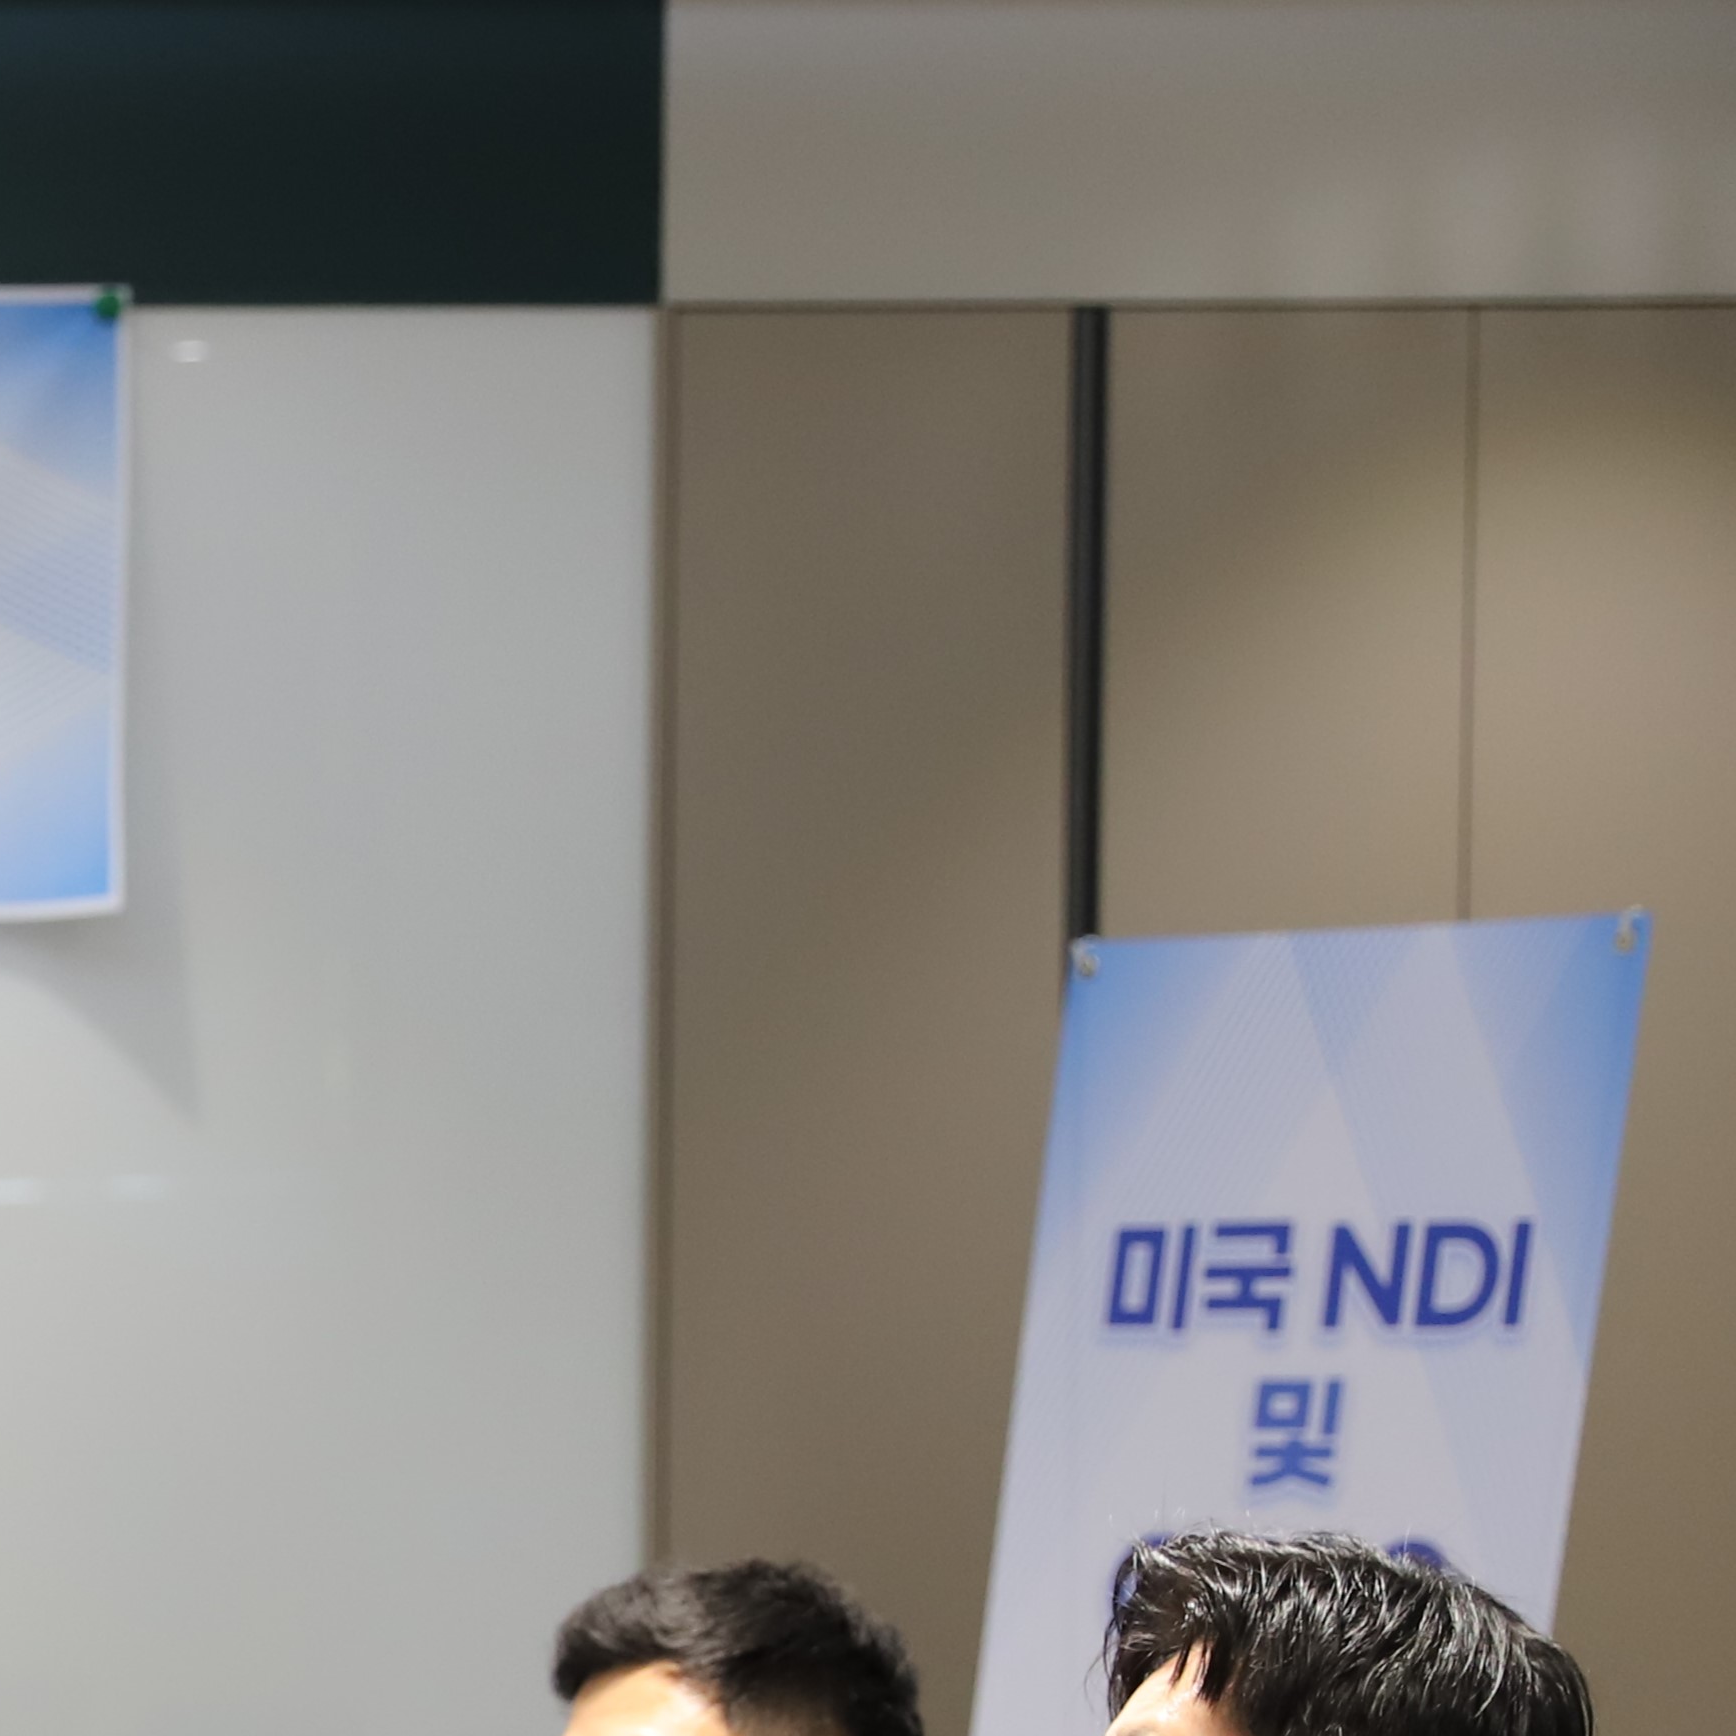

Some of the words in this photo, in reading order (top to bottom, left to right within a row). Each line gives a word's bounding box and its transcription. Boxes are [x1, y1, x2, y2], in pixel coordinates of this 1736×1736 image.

[1106, 1222, 1293, 1331] 미국
[1322, 1221, 1534, 1329] NDI
[1246, 1378, 1344, 1487] 및
